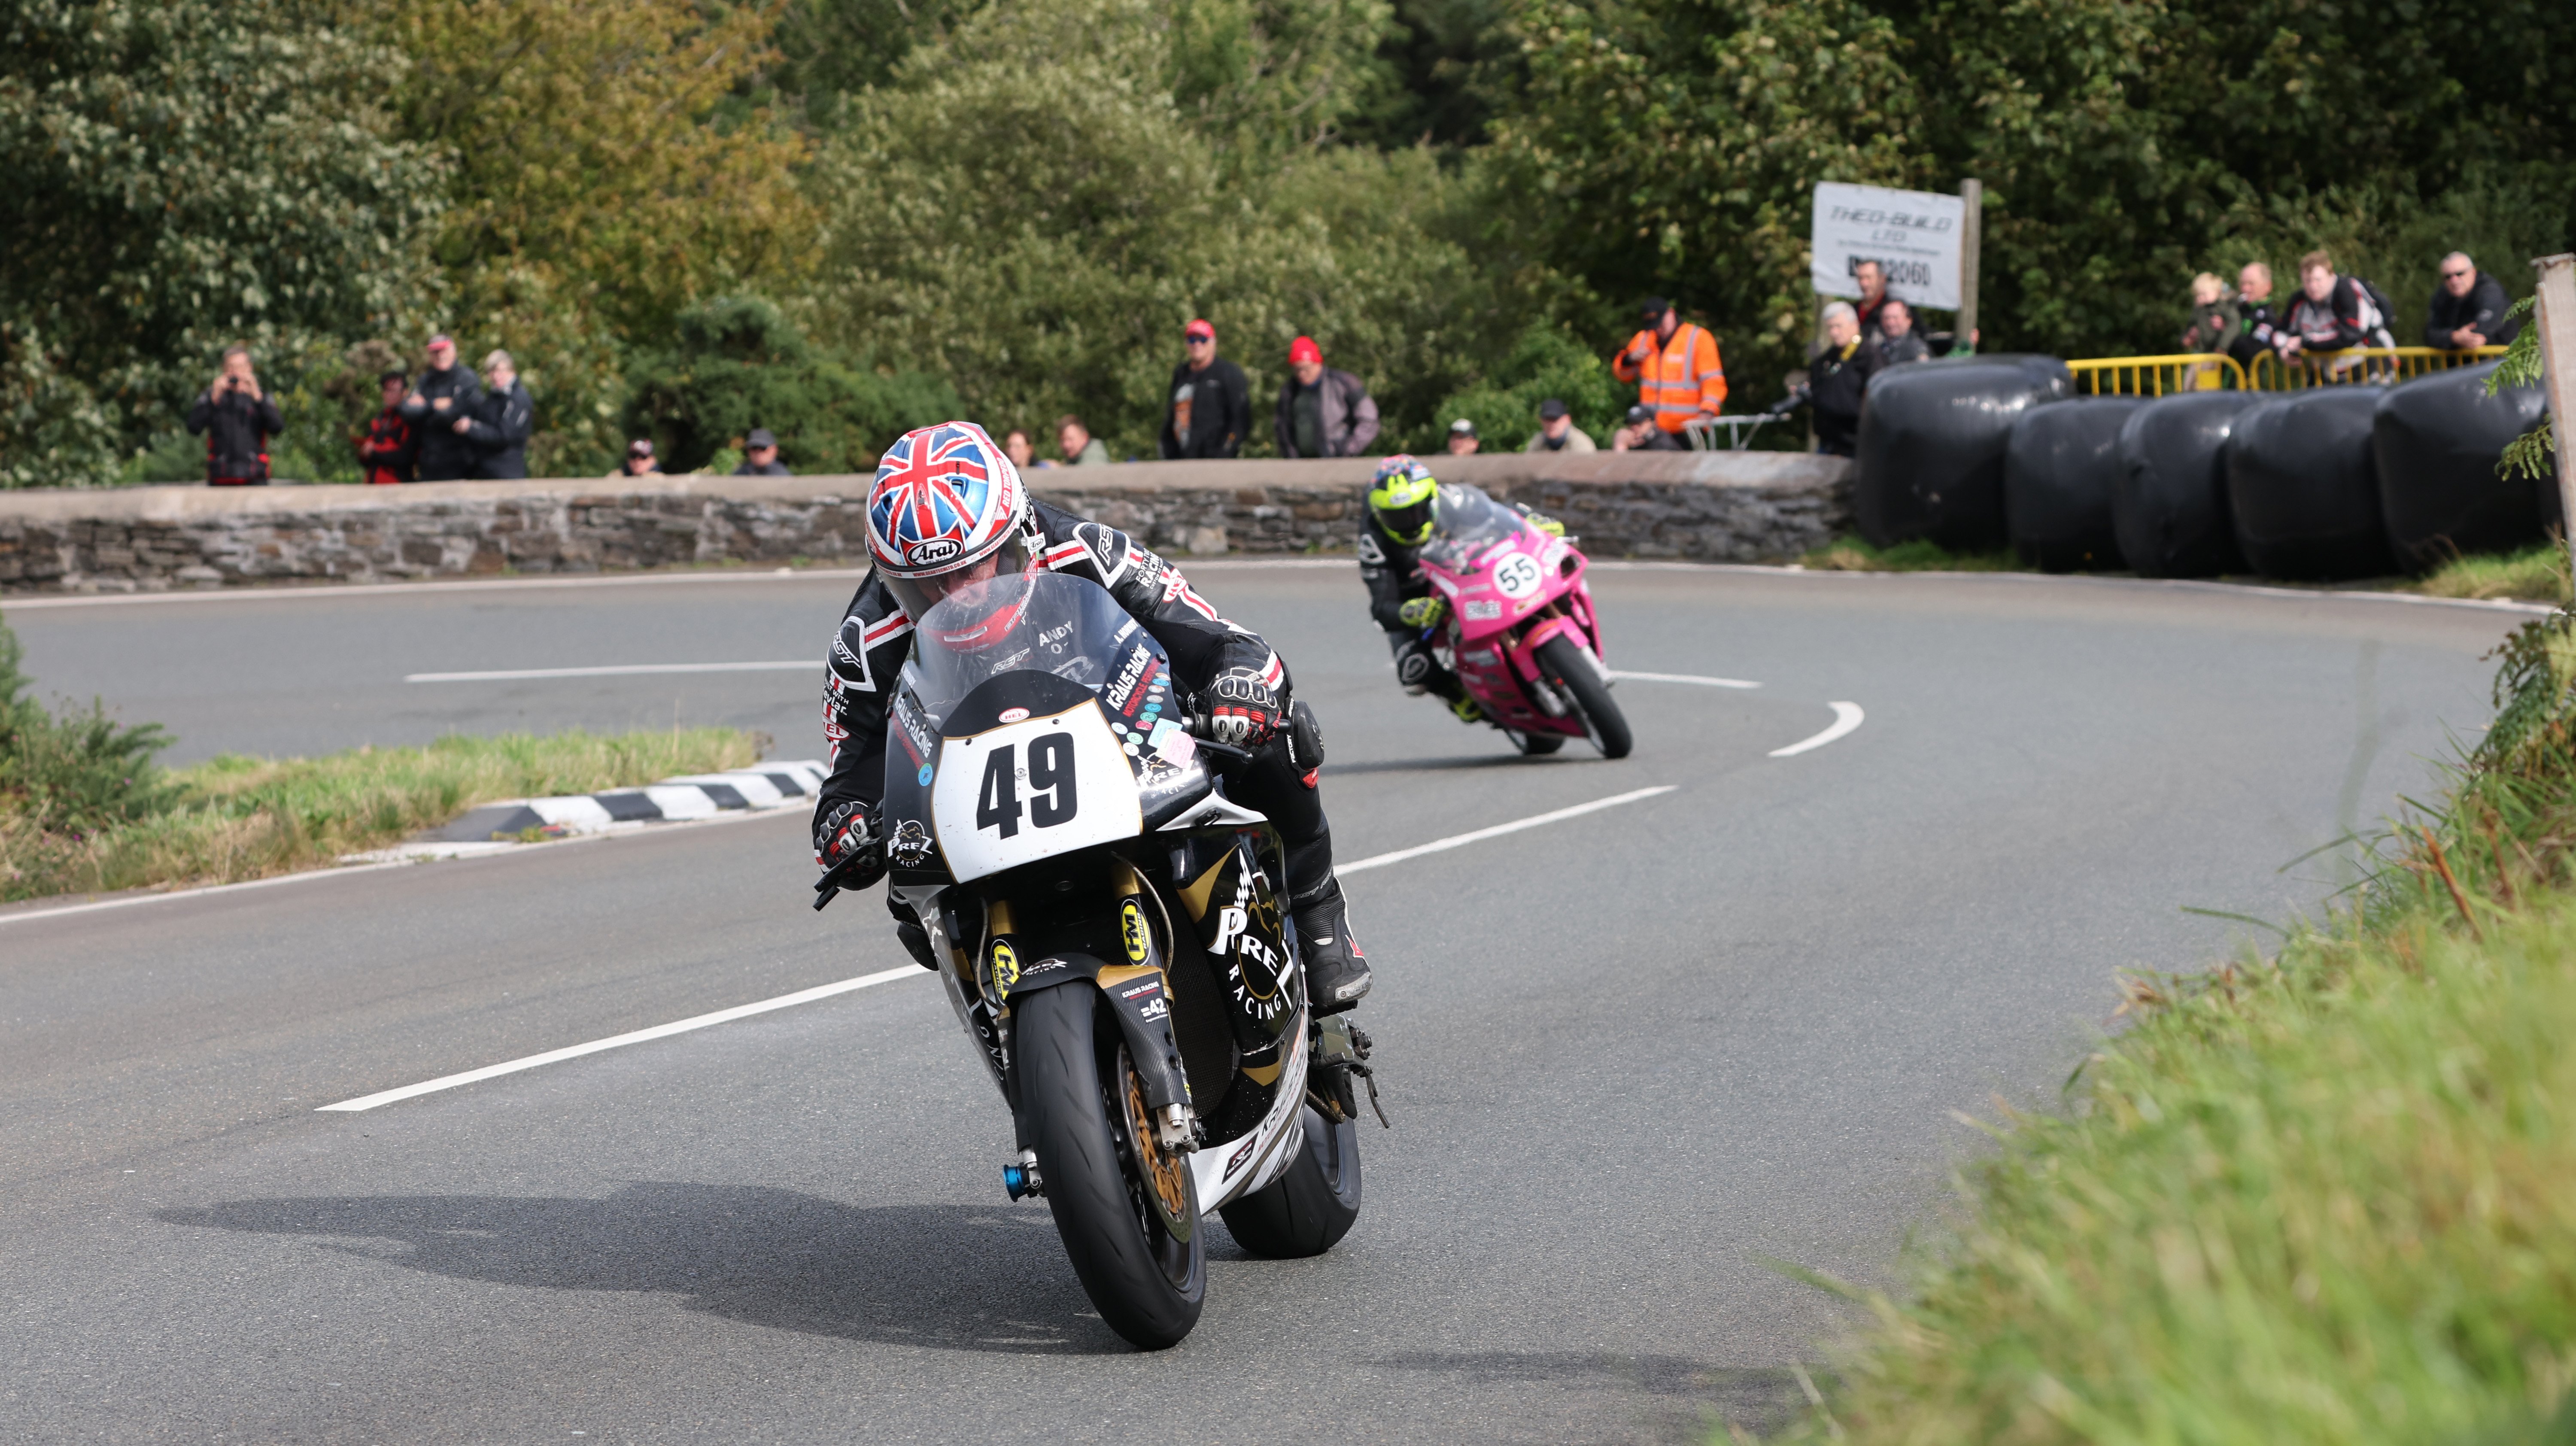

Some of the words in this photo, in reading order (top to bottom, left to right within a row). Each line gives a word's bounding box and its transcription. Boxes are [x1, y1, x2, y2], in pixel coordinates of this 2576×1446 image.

[1872, 228, 1907, 243] LTD
[996, 457, 1011, 489] TORPEDO
[1002, 490, 1012, 507] RED
[912, 540, 955, 562] Arai
[1031, 538, 1042, 548] Arai
[1136, 556, 1150, 582] FORTY
[1498, 557, 1536, 592] 55
[1039, 620, 1073, 647] ANDY
[1118, 617, 1139, 640] HORNBY
[833, 631, 861, 668] RST
[991, 647, 1030, 674] RST
[1106, 670, 1137, 711] KRAUS
[1125, 642, 1151, 678] RACING
[823, 689, 847, 714] evlar
[832, 688, 850, 705] WITH
[895, 692, 913, 729] KRAUS
[908, 719, 933, 759] RACING
[1005, 711, 1024, 721] HEL
[976, 732, 1078, 840] 49
[887, 835, 933, 858] PREZ
[896, 854, 924, 867] RACING
[1293, 886, 1319, 899] RST
[1124, 913, 1141, 952] HM
[1136, 912, 1148, 950] RACING
[1207, 908, 1294, 1010] PREZ
[1122, 986, 1142, 999] KRAUS
[1140, 981, 1160, 992] RACING
[1228, 964, 1281, 1020] RACING
